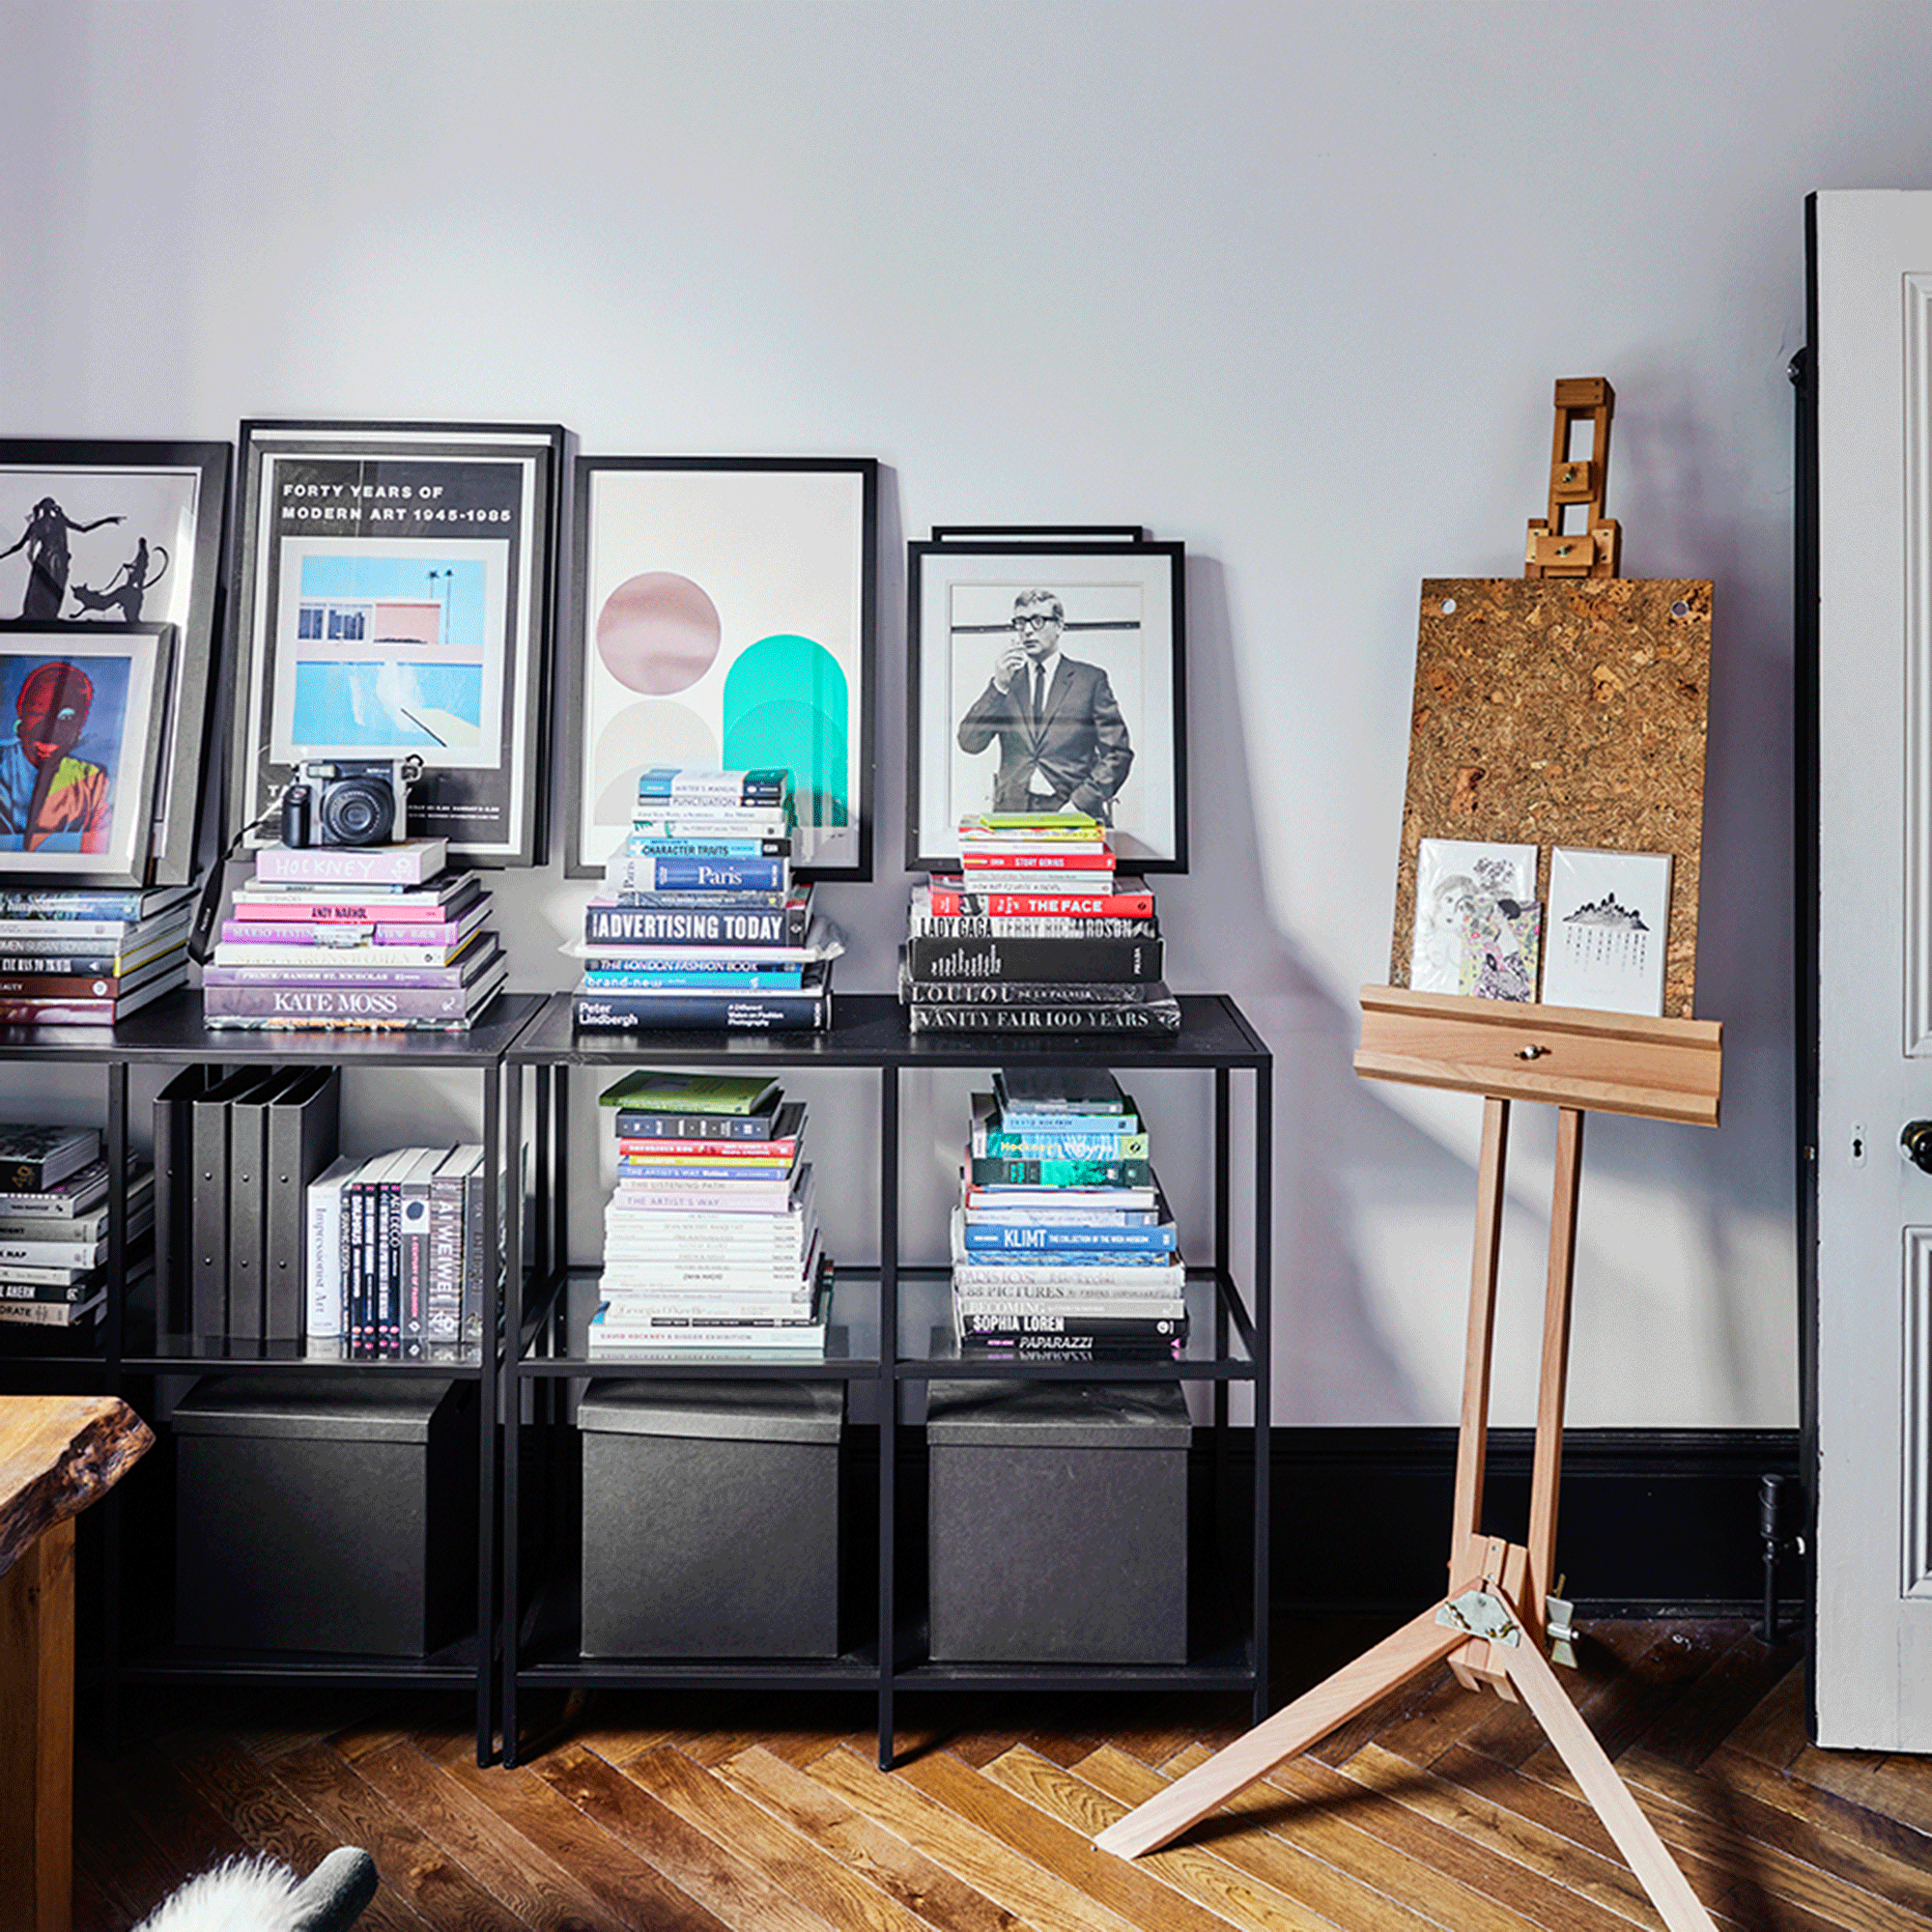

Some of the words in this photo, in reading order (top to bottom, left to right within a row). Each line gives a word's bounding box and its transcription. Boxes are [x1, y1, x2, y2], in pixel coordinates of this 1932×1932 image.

[282, 484, 344, 497] FORTY
[350, 484, 412, 498] YEARS
[418, 486, 444, 499] OF
[281, 506, 362, 520] MODERN
[369, 507, 408, 521] ART
[412, 508, 512, 523] 1945-1985
[672, 797, 737, 807] PUNCTUATION
[642, 844, 696, 856] CHARACTER
[696, 845, 729, 856] TRAITS
[275, 856, 377, 878] HOCKNEY
[1014, 858, 1037, 867] STORY
[696, 866, 743, 885] Paris
[1028, 899, 1059, 912] THE
[1061, 900, 1103, 913] FACE
[275, 928, 313, 938] TESTIN
[724, 915, 782, 940] TODAY
[921, 918, 955, 937] LADY
[957, 918, 993, 938] GAGA
[998, 919, 1039, 938] TERRY
[600, 959, 622, 970] THE
[623, 960, 672, 971] LONDON
[673, 960, 723, 972] FASHION
[726, 961, 758, 972] BOOK
[586, 976, 664, 987] brand-new
[912, 985, 1014, 1003] LOULOU
[273, 993, 333, 1012] KATE
[337, 993, 398, 1013] MOSS
[580, 1002, 611, 1013] Peter
[580, 1013, 639, 1027] Lindbergh
[917, 1010, 990, 1028] VANITY
[997, 1011, 1041, 1028] FAIR
[1045, 1011, 1082, 1027] 100
[1086, 1011, 1150, 1028] YEARS
[438, 1200, 452, 1220] AI
[627, 1197, 646, 1207] THE
[697, 1198, 721, 1208] WAY
[1004, 1229, 1047, 1247] KLIMT
[314, 1208, 327, 1288] Impressionist
[438, 1224, 452, 1299] WEIWEI
[987, 1287, 1065, 1298] PICTURES
[314, 1293, 327, 1314] Art
[973, 1316, 1020, 1332] SOPHIA
[1023, 1316, 1065, 1332] LOREN
[1019, 1336, 1094, 1350] PAPARAZZI
